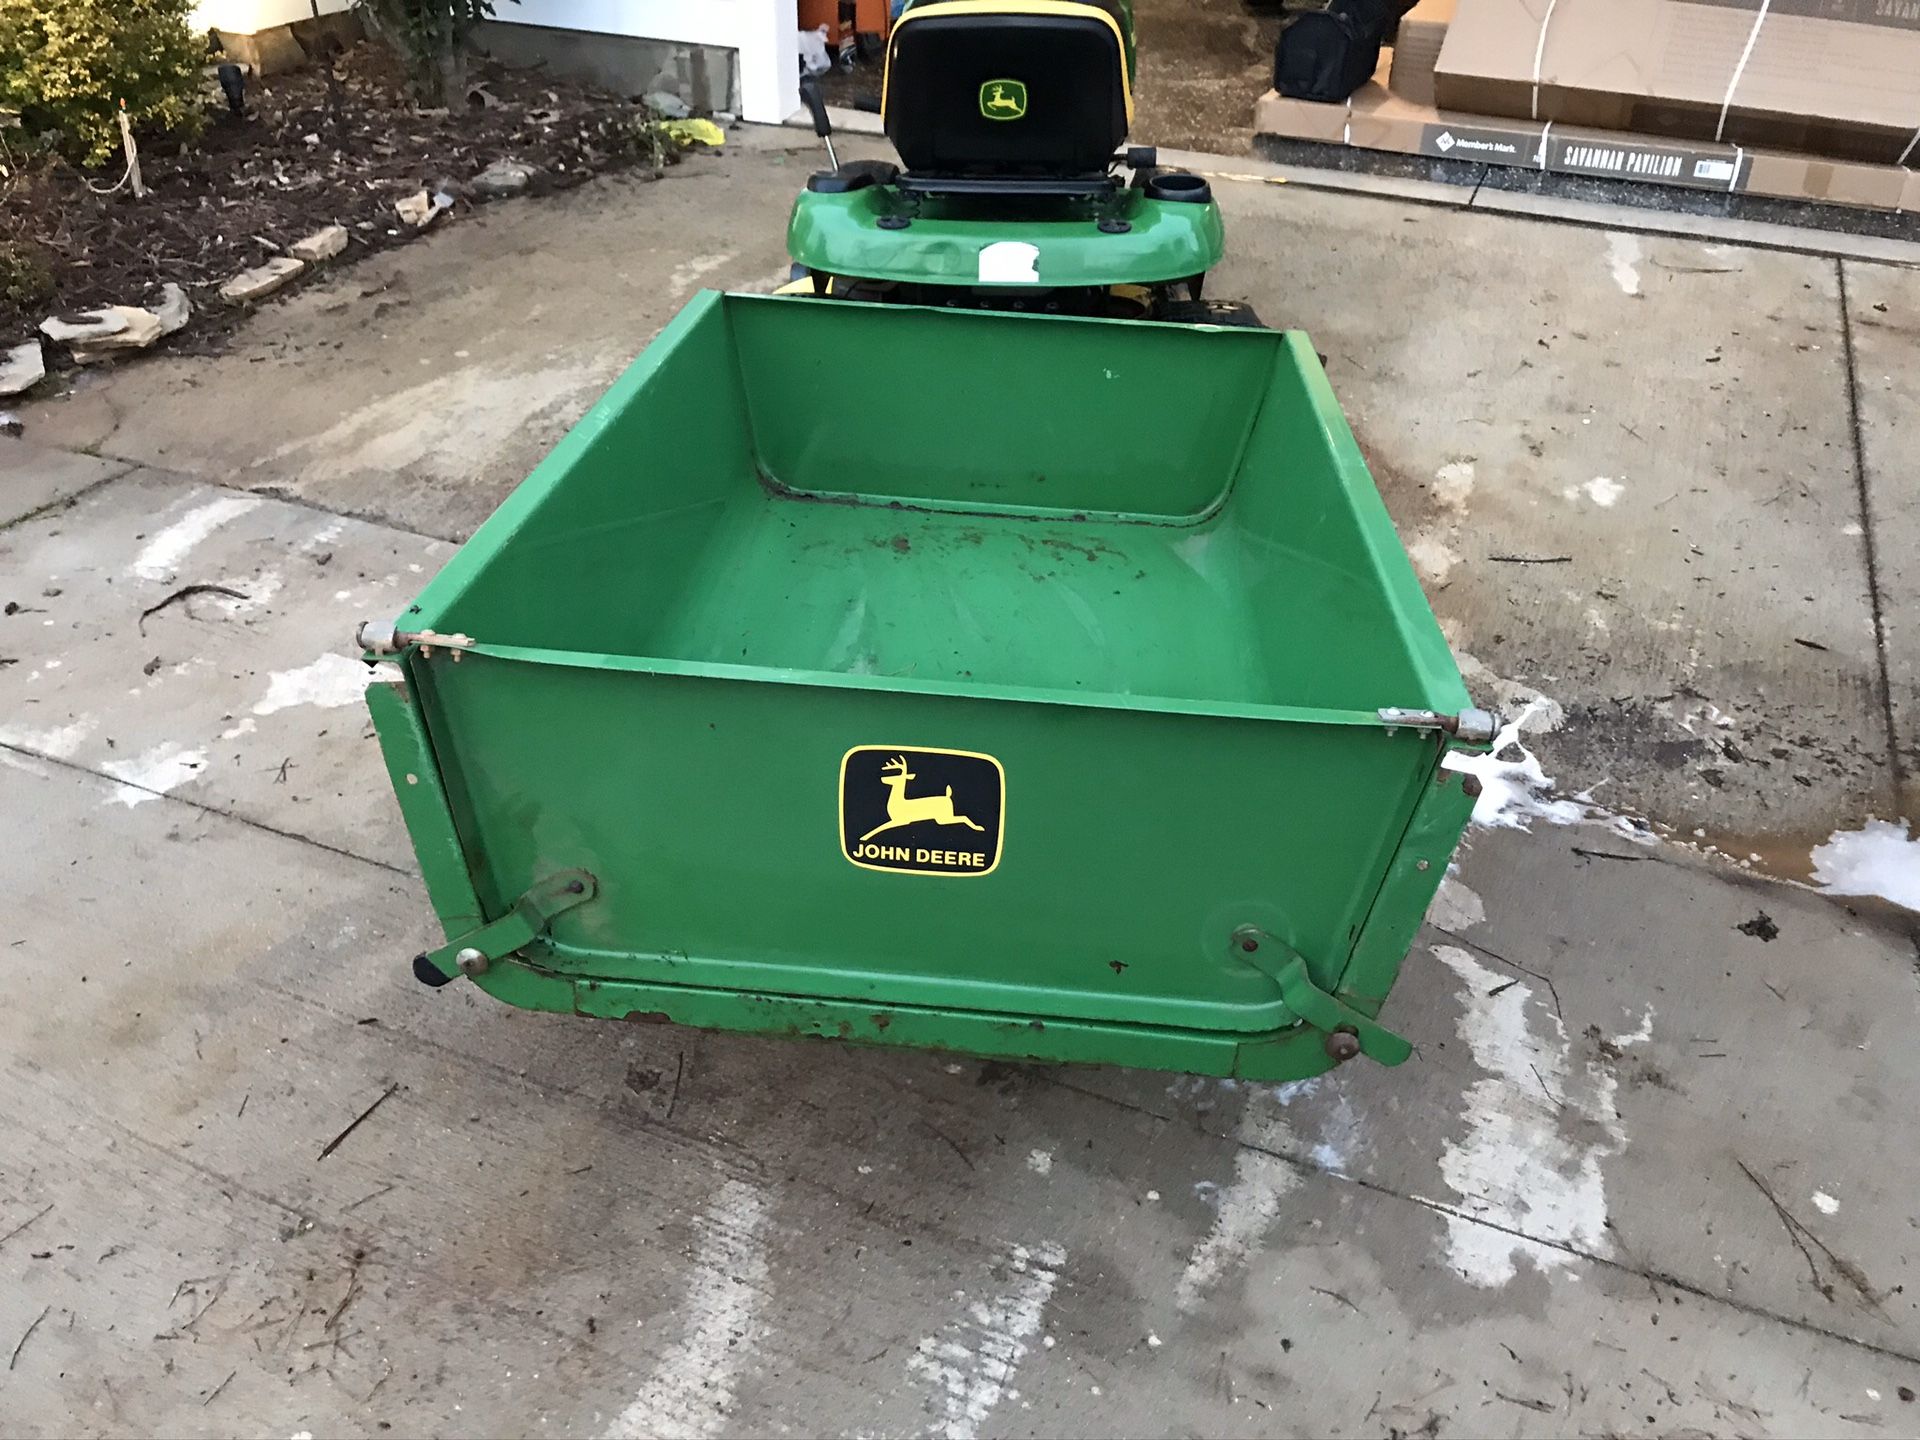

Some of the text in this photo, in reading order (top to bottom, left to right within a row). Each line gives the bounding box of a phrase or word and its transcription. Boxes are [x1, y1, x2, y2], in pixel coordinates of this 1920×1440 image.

[1456, 138, 1493, 151] Member's
[1564, 146, 1683, 177] SAVANNAH PAVILION
[853, 844, 985, 867] JOHN DEERE
